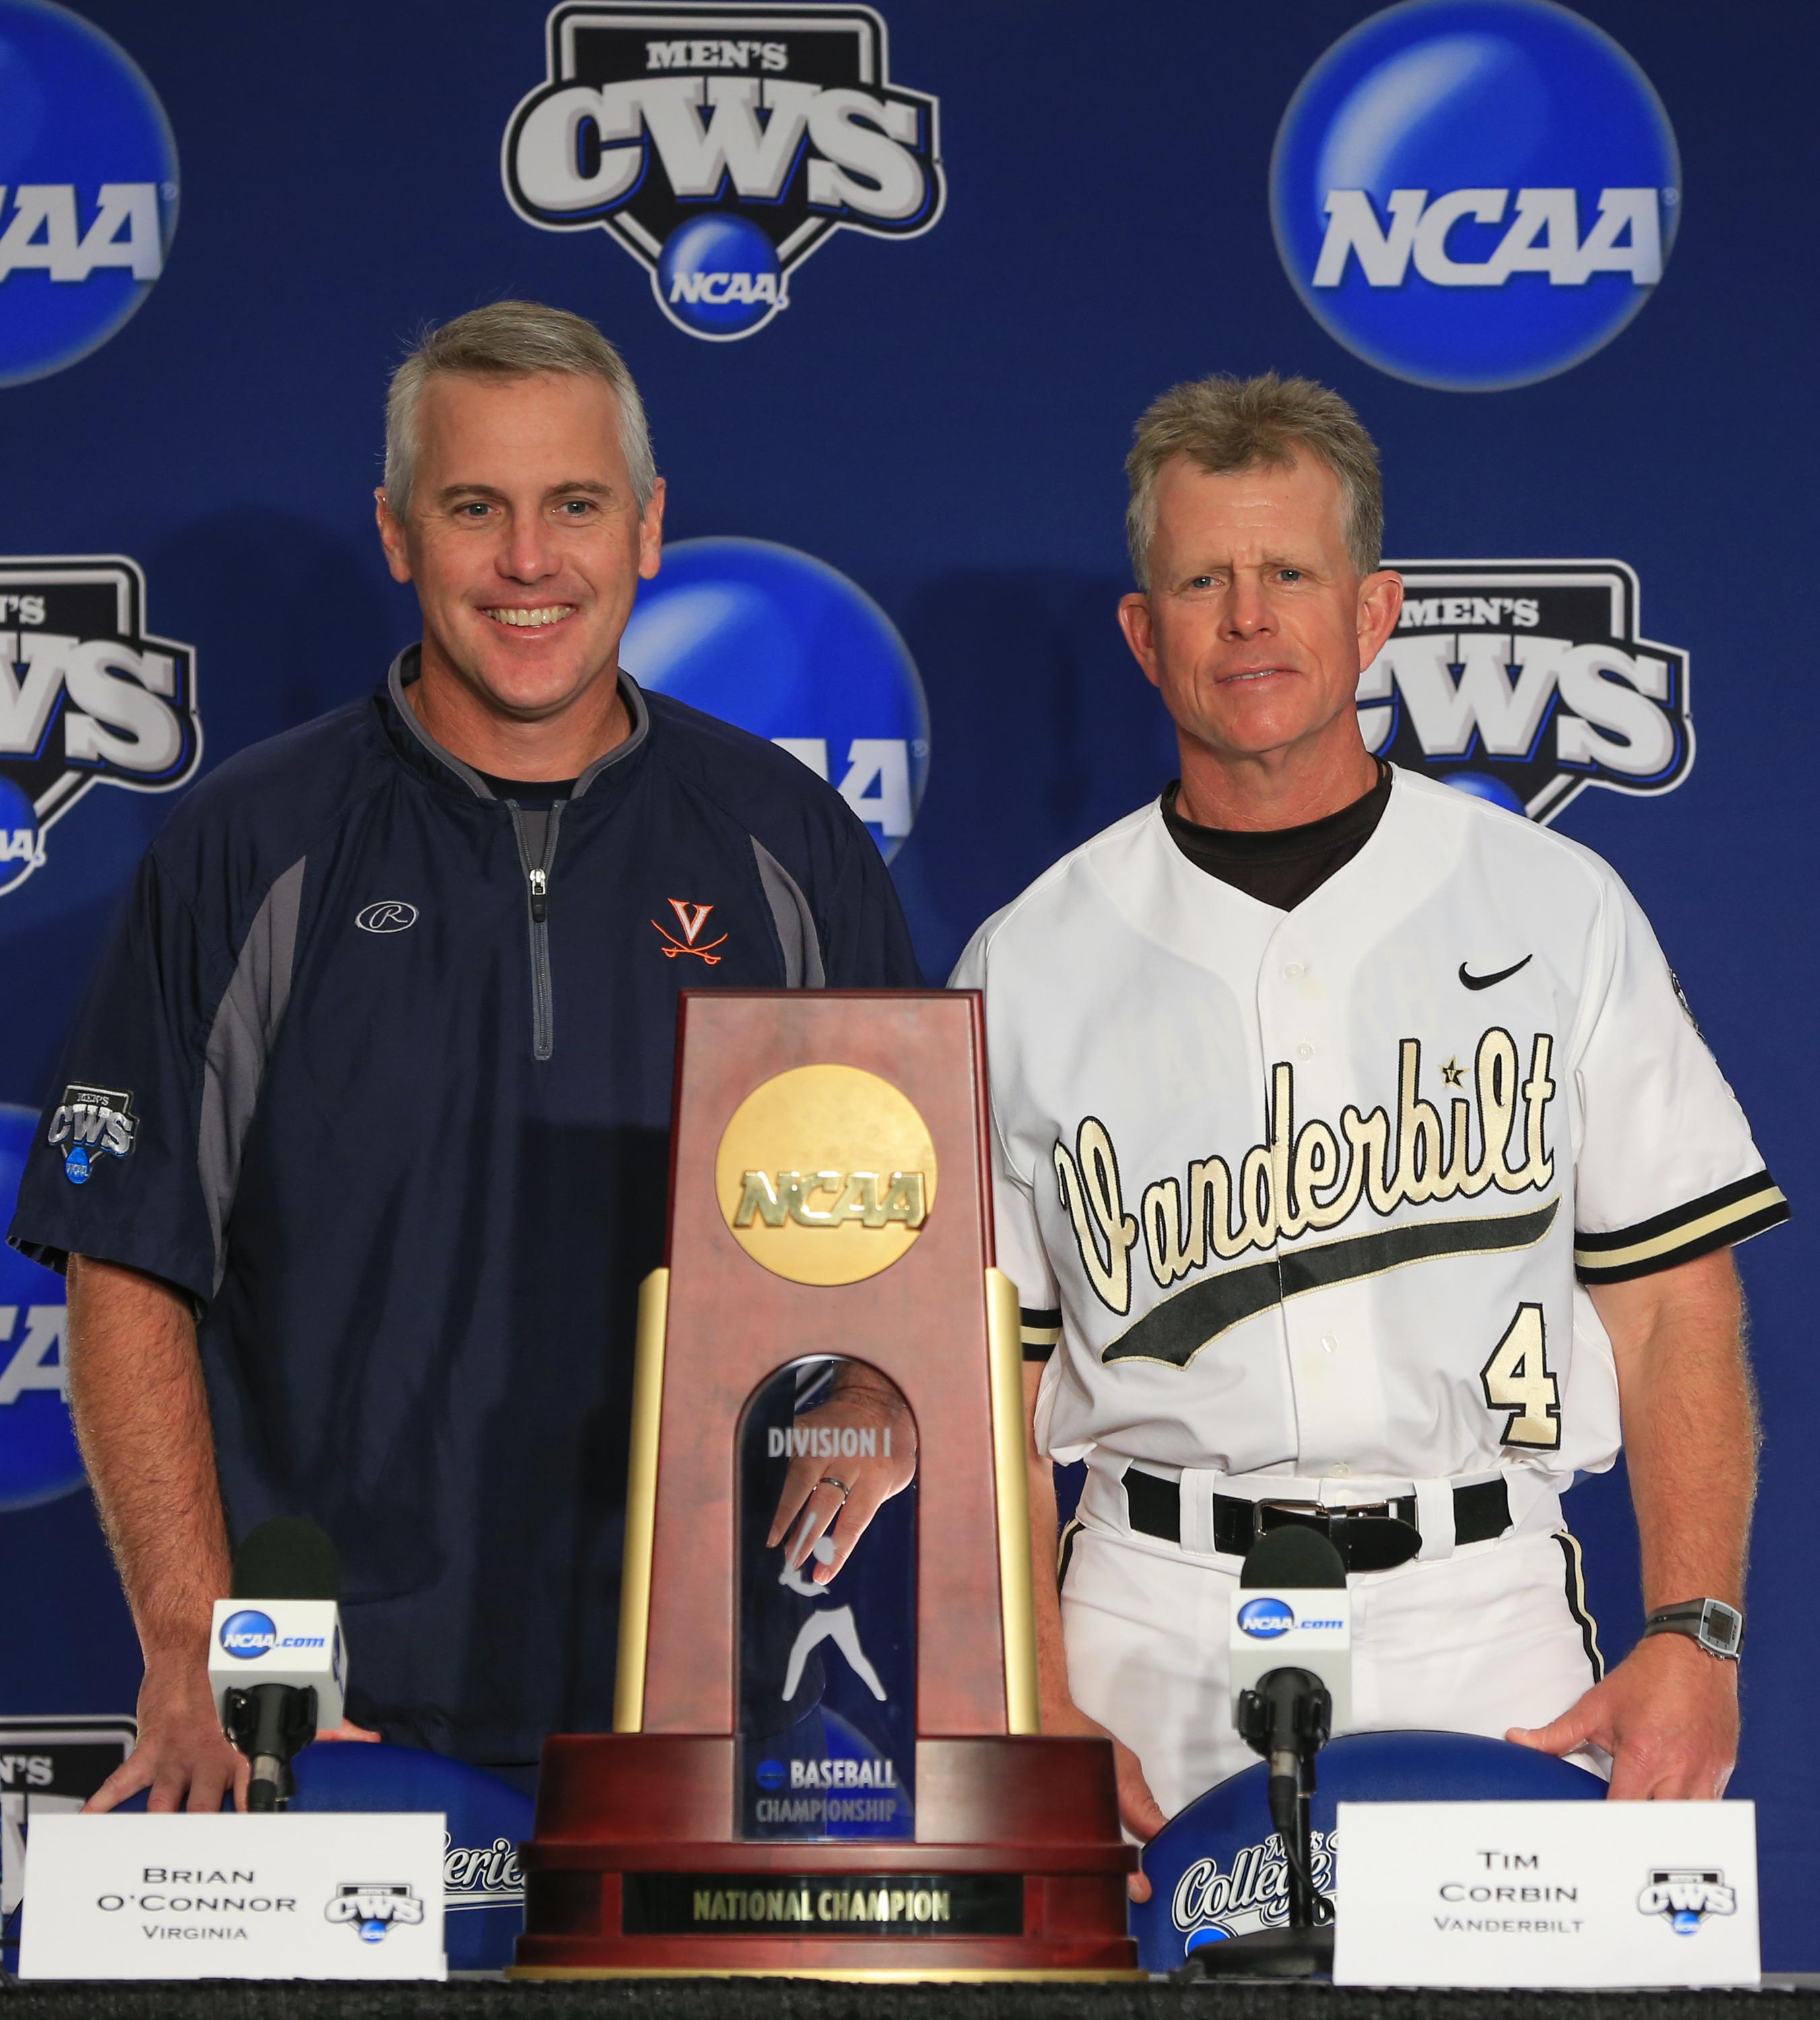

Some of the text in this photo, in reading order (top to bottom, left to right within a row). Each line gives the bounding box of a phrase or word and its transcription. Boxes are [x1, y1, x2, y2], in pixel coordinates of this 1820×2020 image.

[646, 40, 788, 71] MEN'S
[514, 75, 926, 220] CWS
[0, 182, 163, 283] AA
[1312, 187, 1663, 287] NCAA
[669, 271, 778, 304] NCAA
[1398, 597, 1540, 628] MEN'S
[48, 1103, 133, 1155] CWS
[1053, 1026, 1556, 1316] Vanderbilt
[733, 1170, 928, 1230] NCAA
[1481, 1302, 1561, 1450] 4
[768, 1426, 892, 1458] DIVISION I
[1242, 1617, 1344, 1632] NCAA.com
[223, 1634, 325, 1649] NCAA.com
[790, 1759, 898, 1790] BASEBALL
[755, 1798, 898, 1823] CHAMPIONSHIP
[143, 1868, 255, 1884] BRIAN
[96, 1895, 296, 1912] O'CONNOR
[693, 1889, 951, 1922] NATIONAL CHAMPION
[1439, 1883, 1578, 1902] CORBIN
[1637, 1883, 1737, 1915] CWS
[324, 1895, 424, 1924] CWS
[1433, 1917, 1584, 1933] VANDERBILT
[141, 1925, 248, 1941] VIRGINIA
